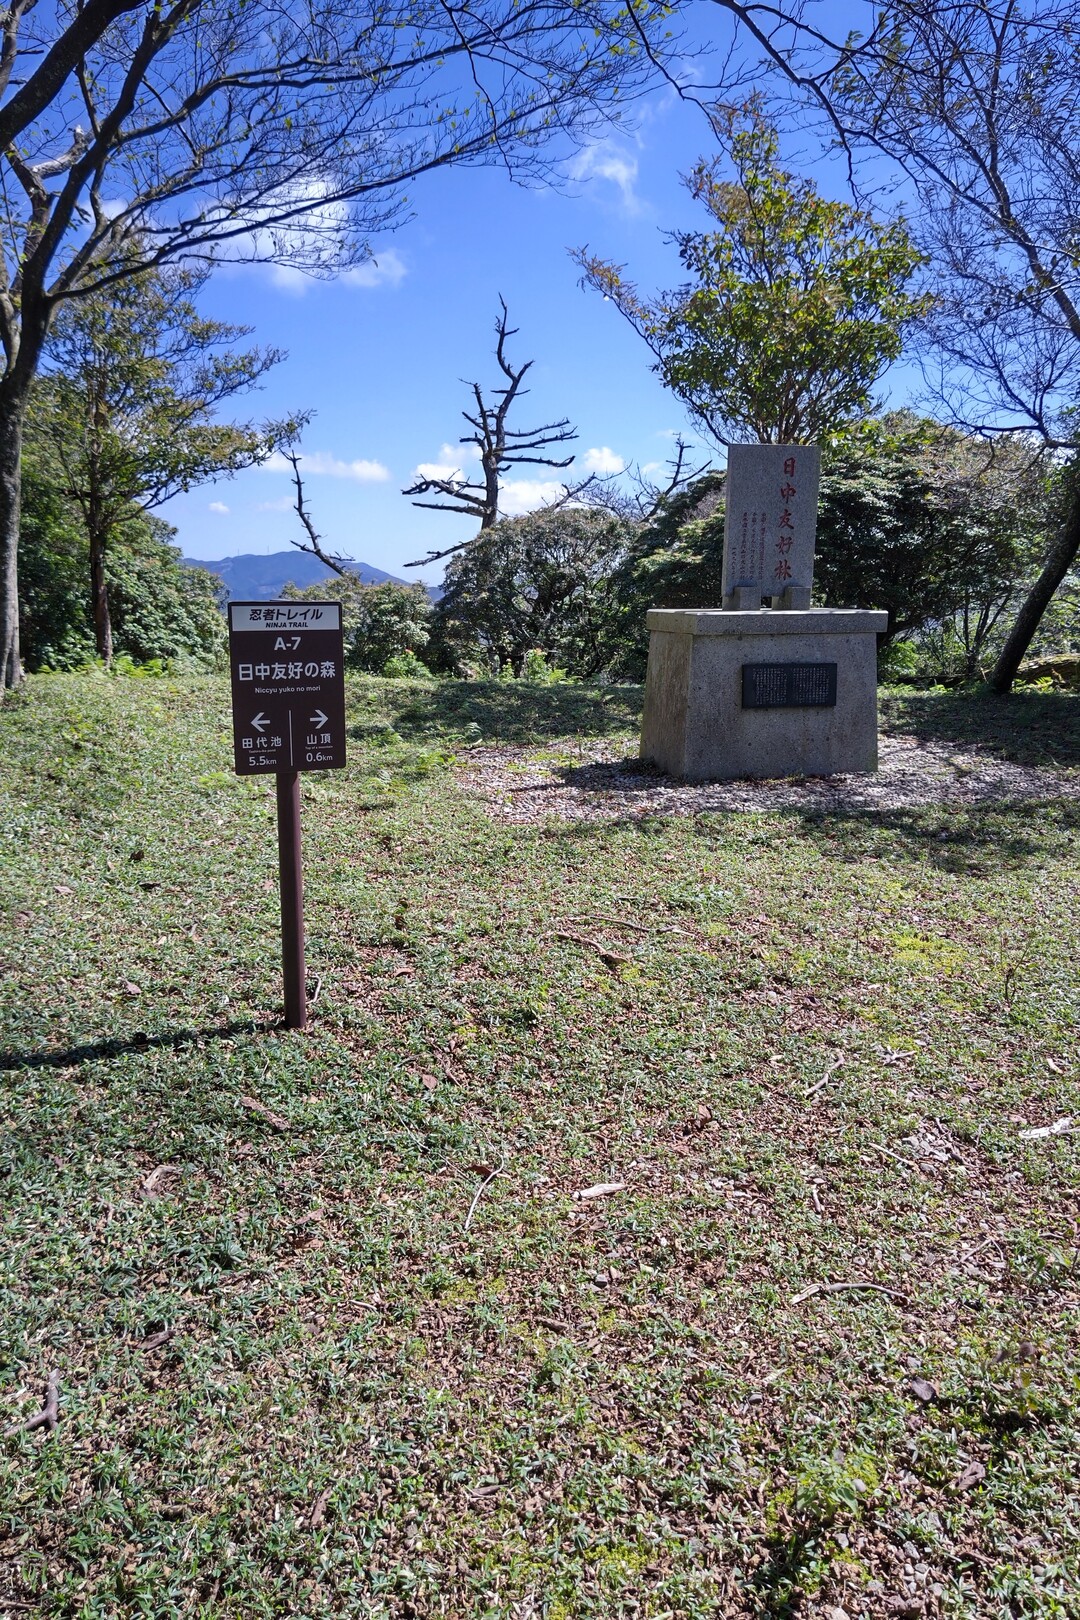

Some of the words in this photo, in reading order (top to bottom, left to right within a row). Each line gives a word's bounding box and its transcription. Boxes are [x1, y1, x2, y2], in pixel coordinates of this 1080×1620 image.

[249, 608, 323, 621] 忍者トレイル
[273, 636, 302, 651] A-7
[238, 660, 336, 681] 日中友好の森
[254, 686, 278, 694] Niccyu
[278, 685, 295, 694] yuko
[242, 735, 282, 749] 田代池
[306, 733, 332, 745] 山頂
[248, 756, 277, 767] 5.5km
[306, 752, 334, 762] 0.6km
